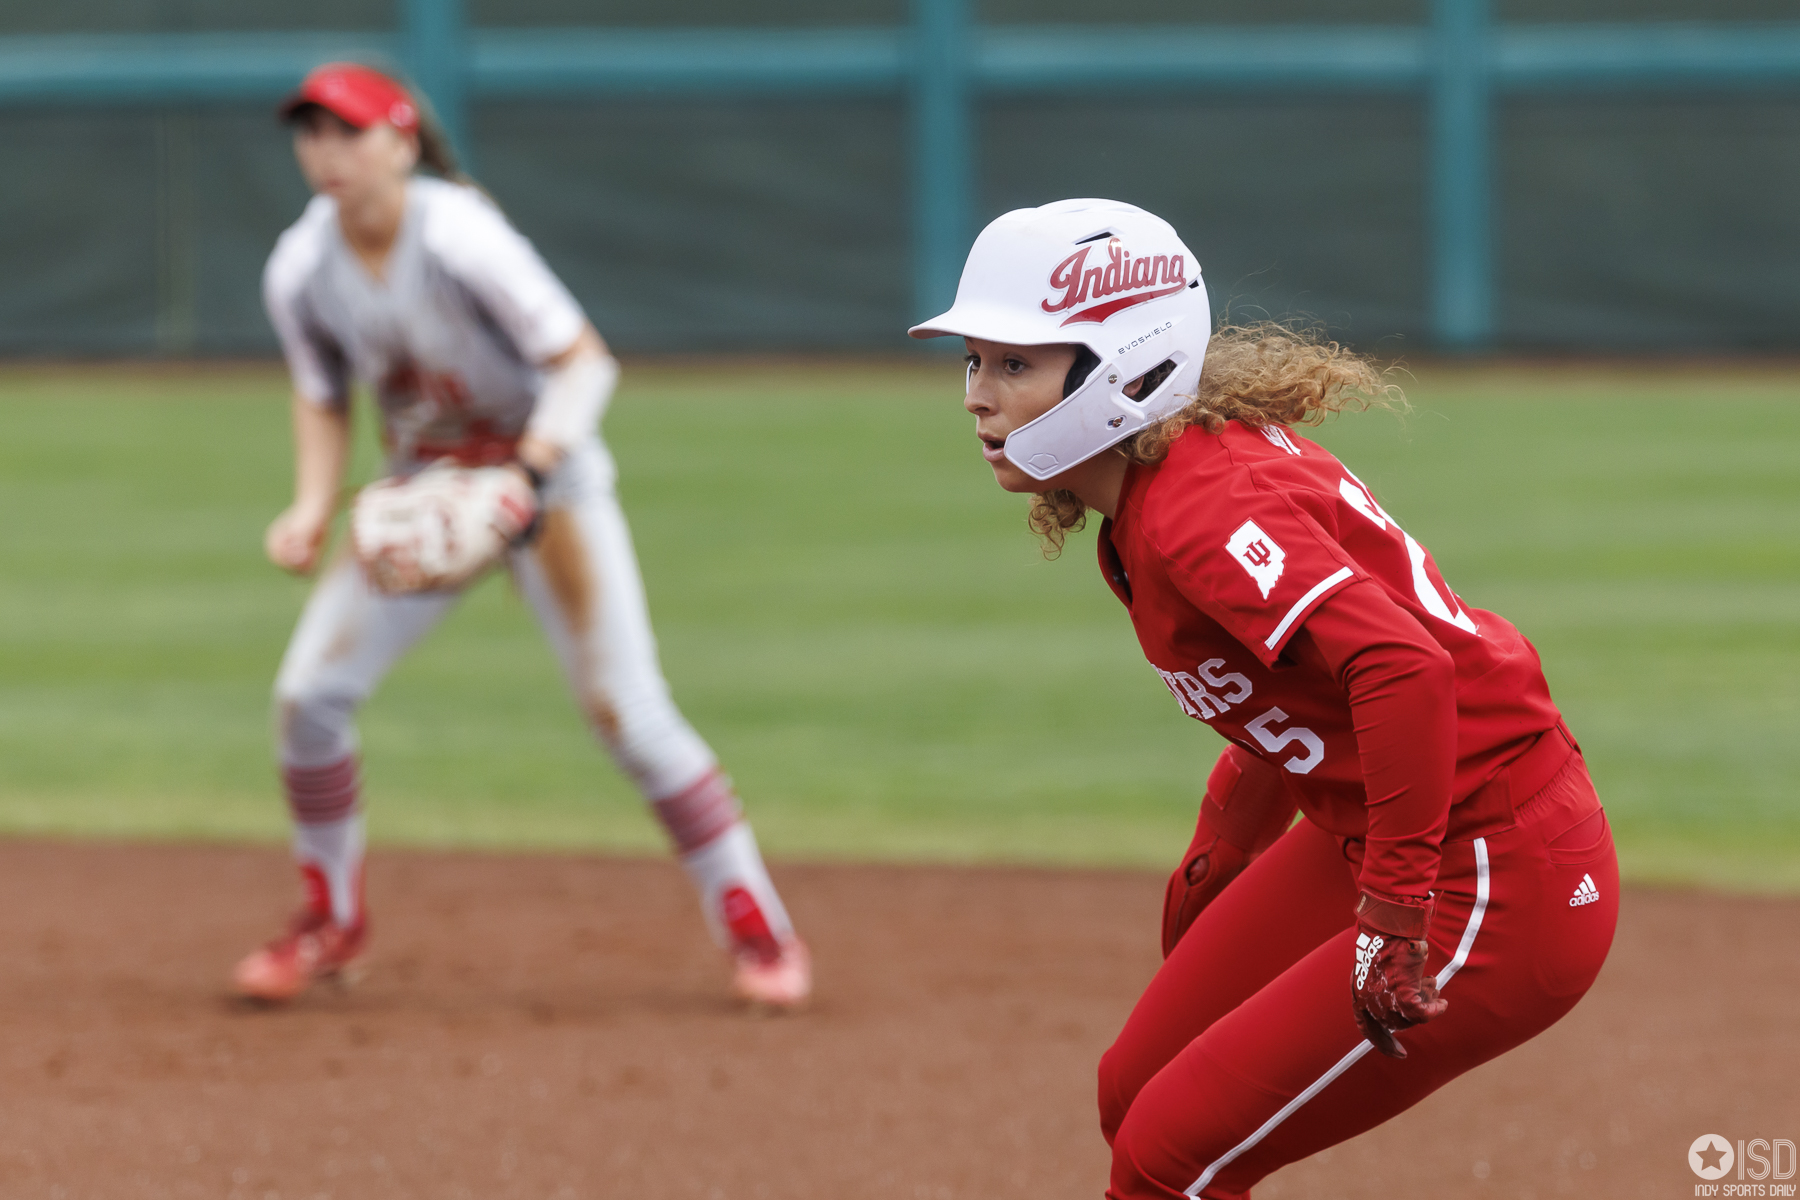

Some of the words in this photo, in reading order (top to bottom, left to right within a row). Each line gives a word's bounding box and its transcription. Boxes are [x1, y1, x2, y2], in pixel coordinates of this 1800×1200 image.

[1041, 237, 1187, 313] Indiana
[1232, 706, 1325, 774] 5
[1569, 891, 1600, 907] adidas
[1356, 935, 1384, 990] adidas
